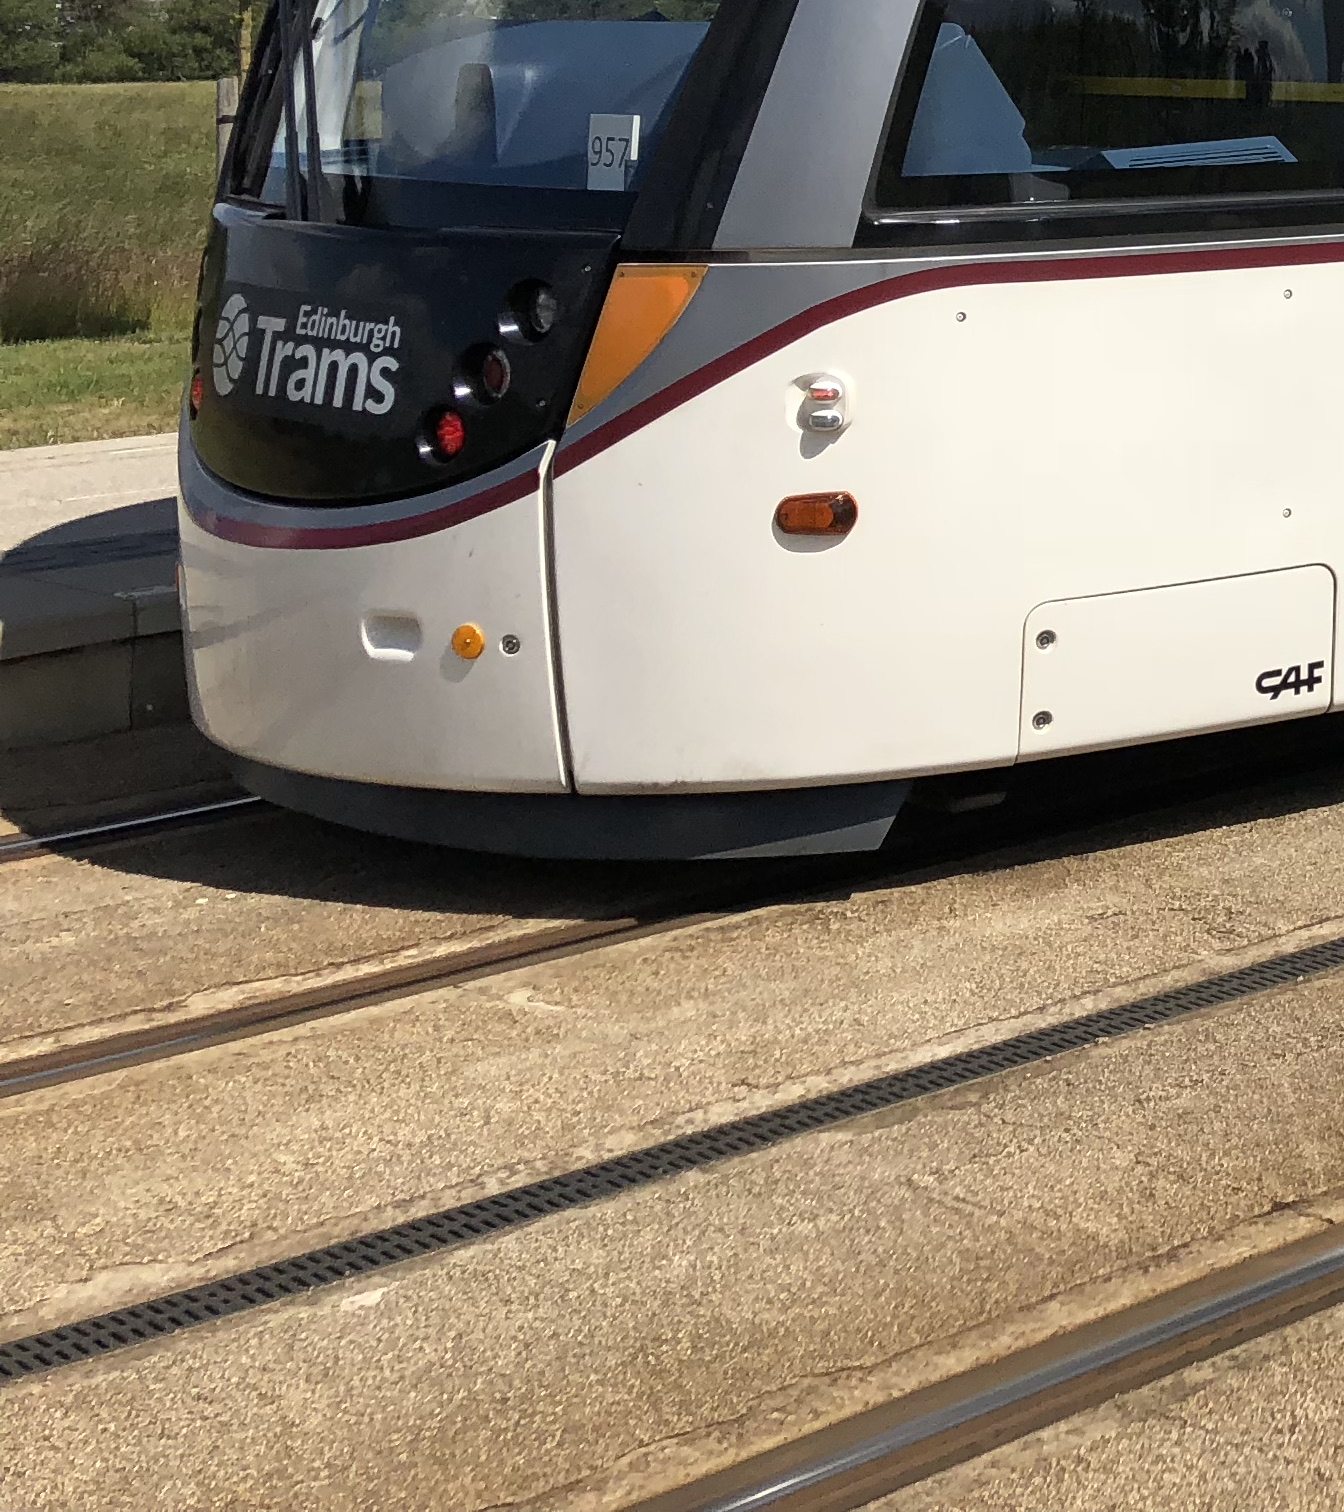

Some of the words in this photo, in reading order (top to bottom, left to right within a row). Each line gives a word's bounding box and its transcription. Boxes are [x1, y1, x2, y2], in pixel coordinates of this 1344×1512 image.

[591, 136, 629, 168] 957
[296, 304, 400, 353] Edinburgh
[255, 316, 400, 415] Trams
[1255, 660, 1324, 700] CAF
